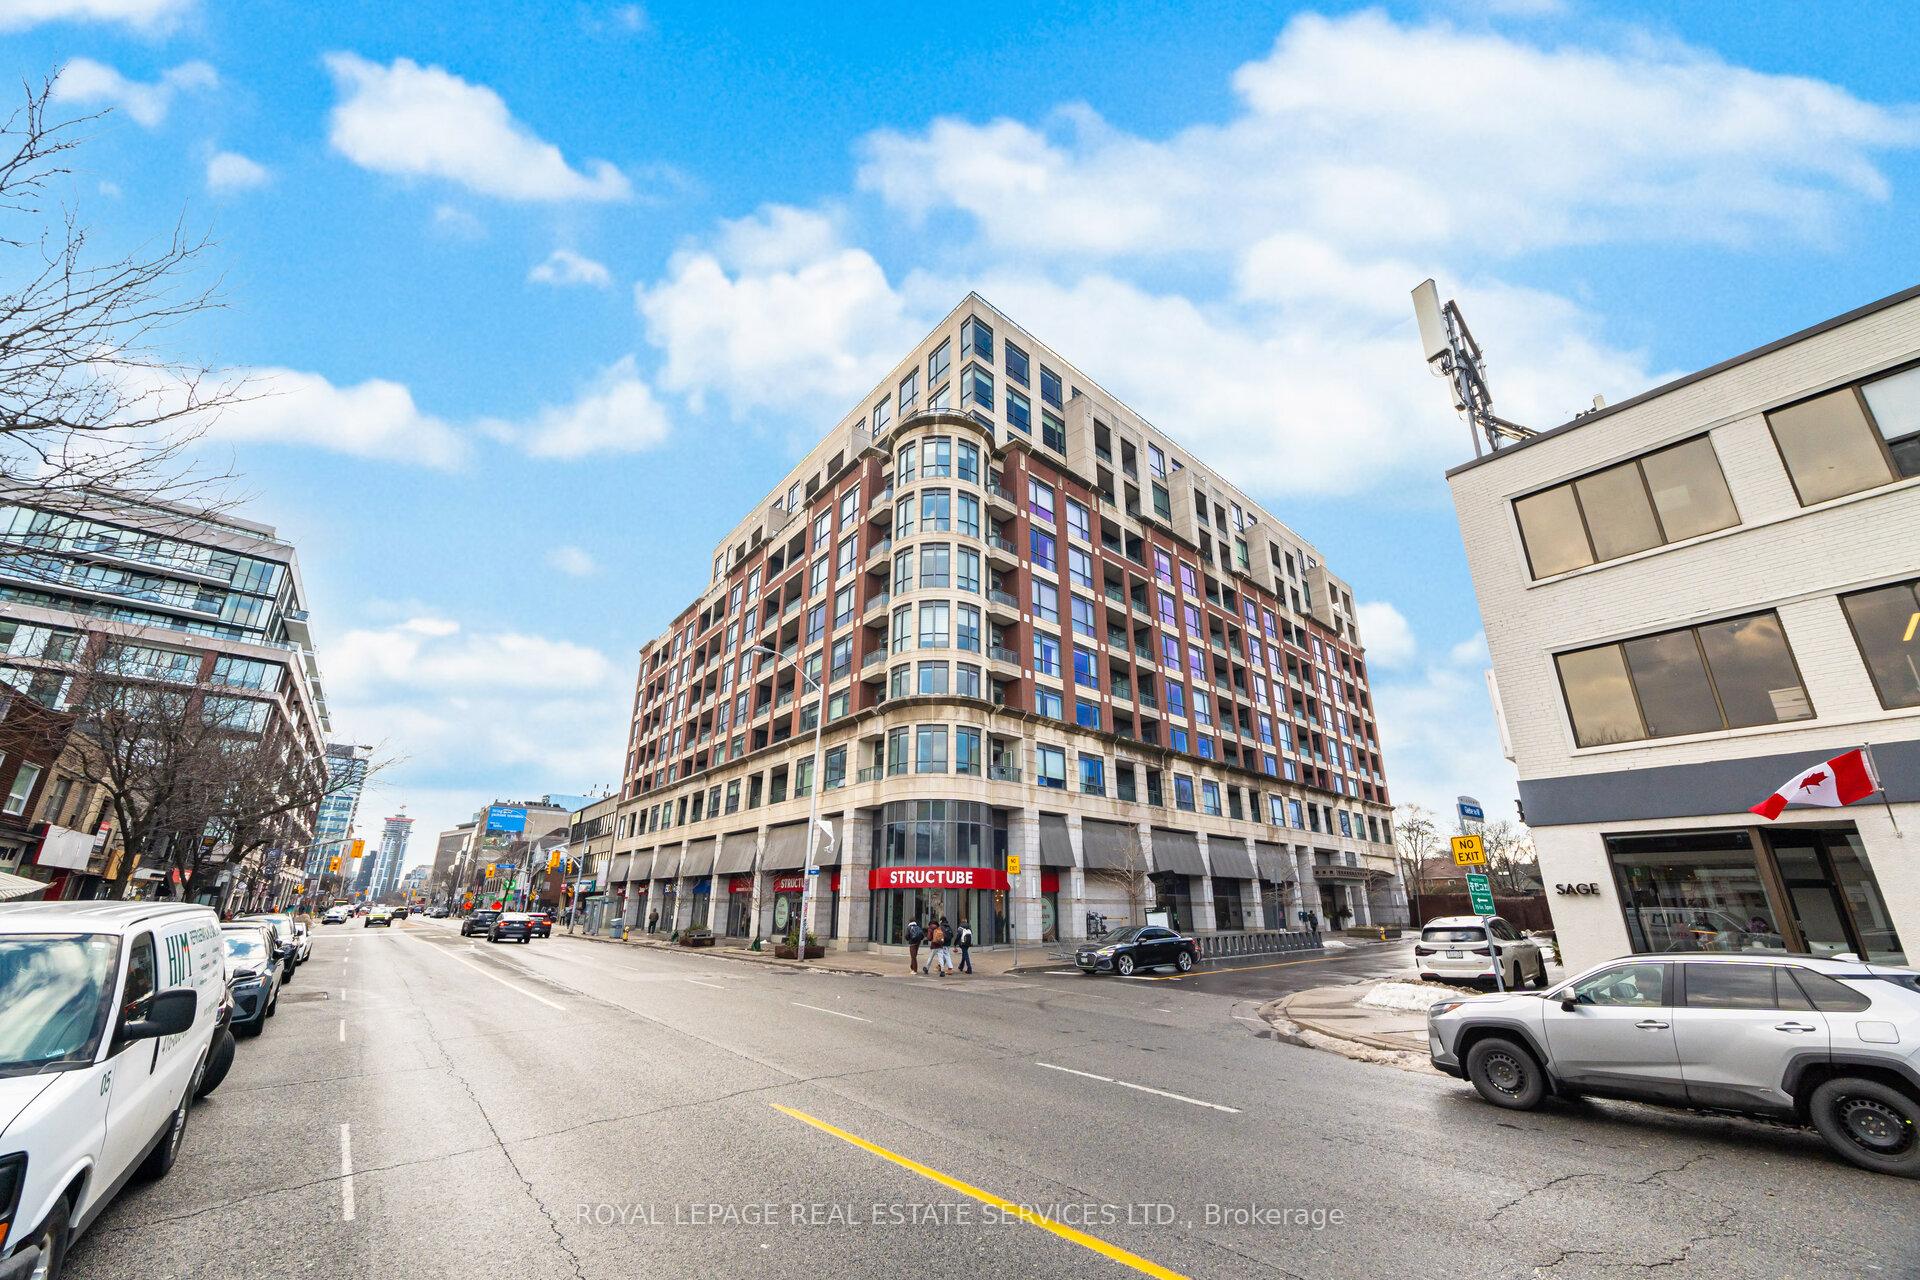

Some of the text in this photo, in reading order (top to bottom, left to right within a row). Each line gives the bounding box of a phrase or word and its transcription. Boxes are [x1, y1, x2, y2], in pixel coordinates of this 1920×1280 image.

[1459, 840, 1474, 849] NO
[1458, 851, 1479, 862] EXIT
[781, 878, 804, 888] STRUCTU
[890, 870, 974, 884] STRUCTUBE
[1555, 882, 1601, 896] SAGE
[165, 932, 192, 987] HIM
